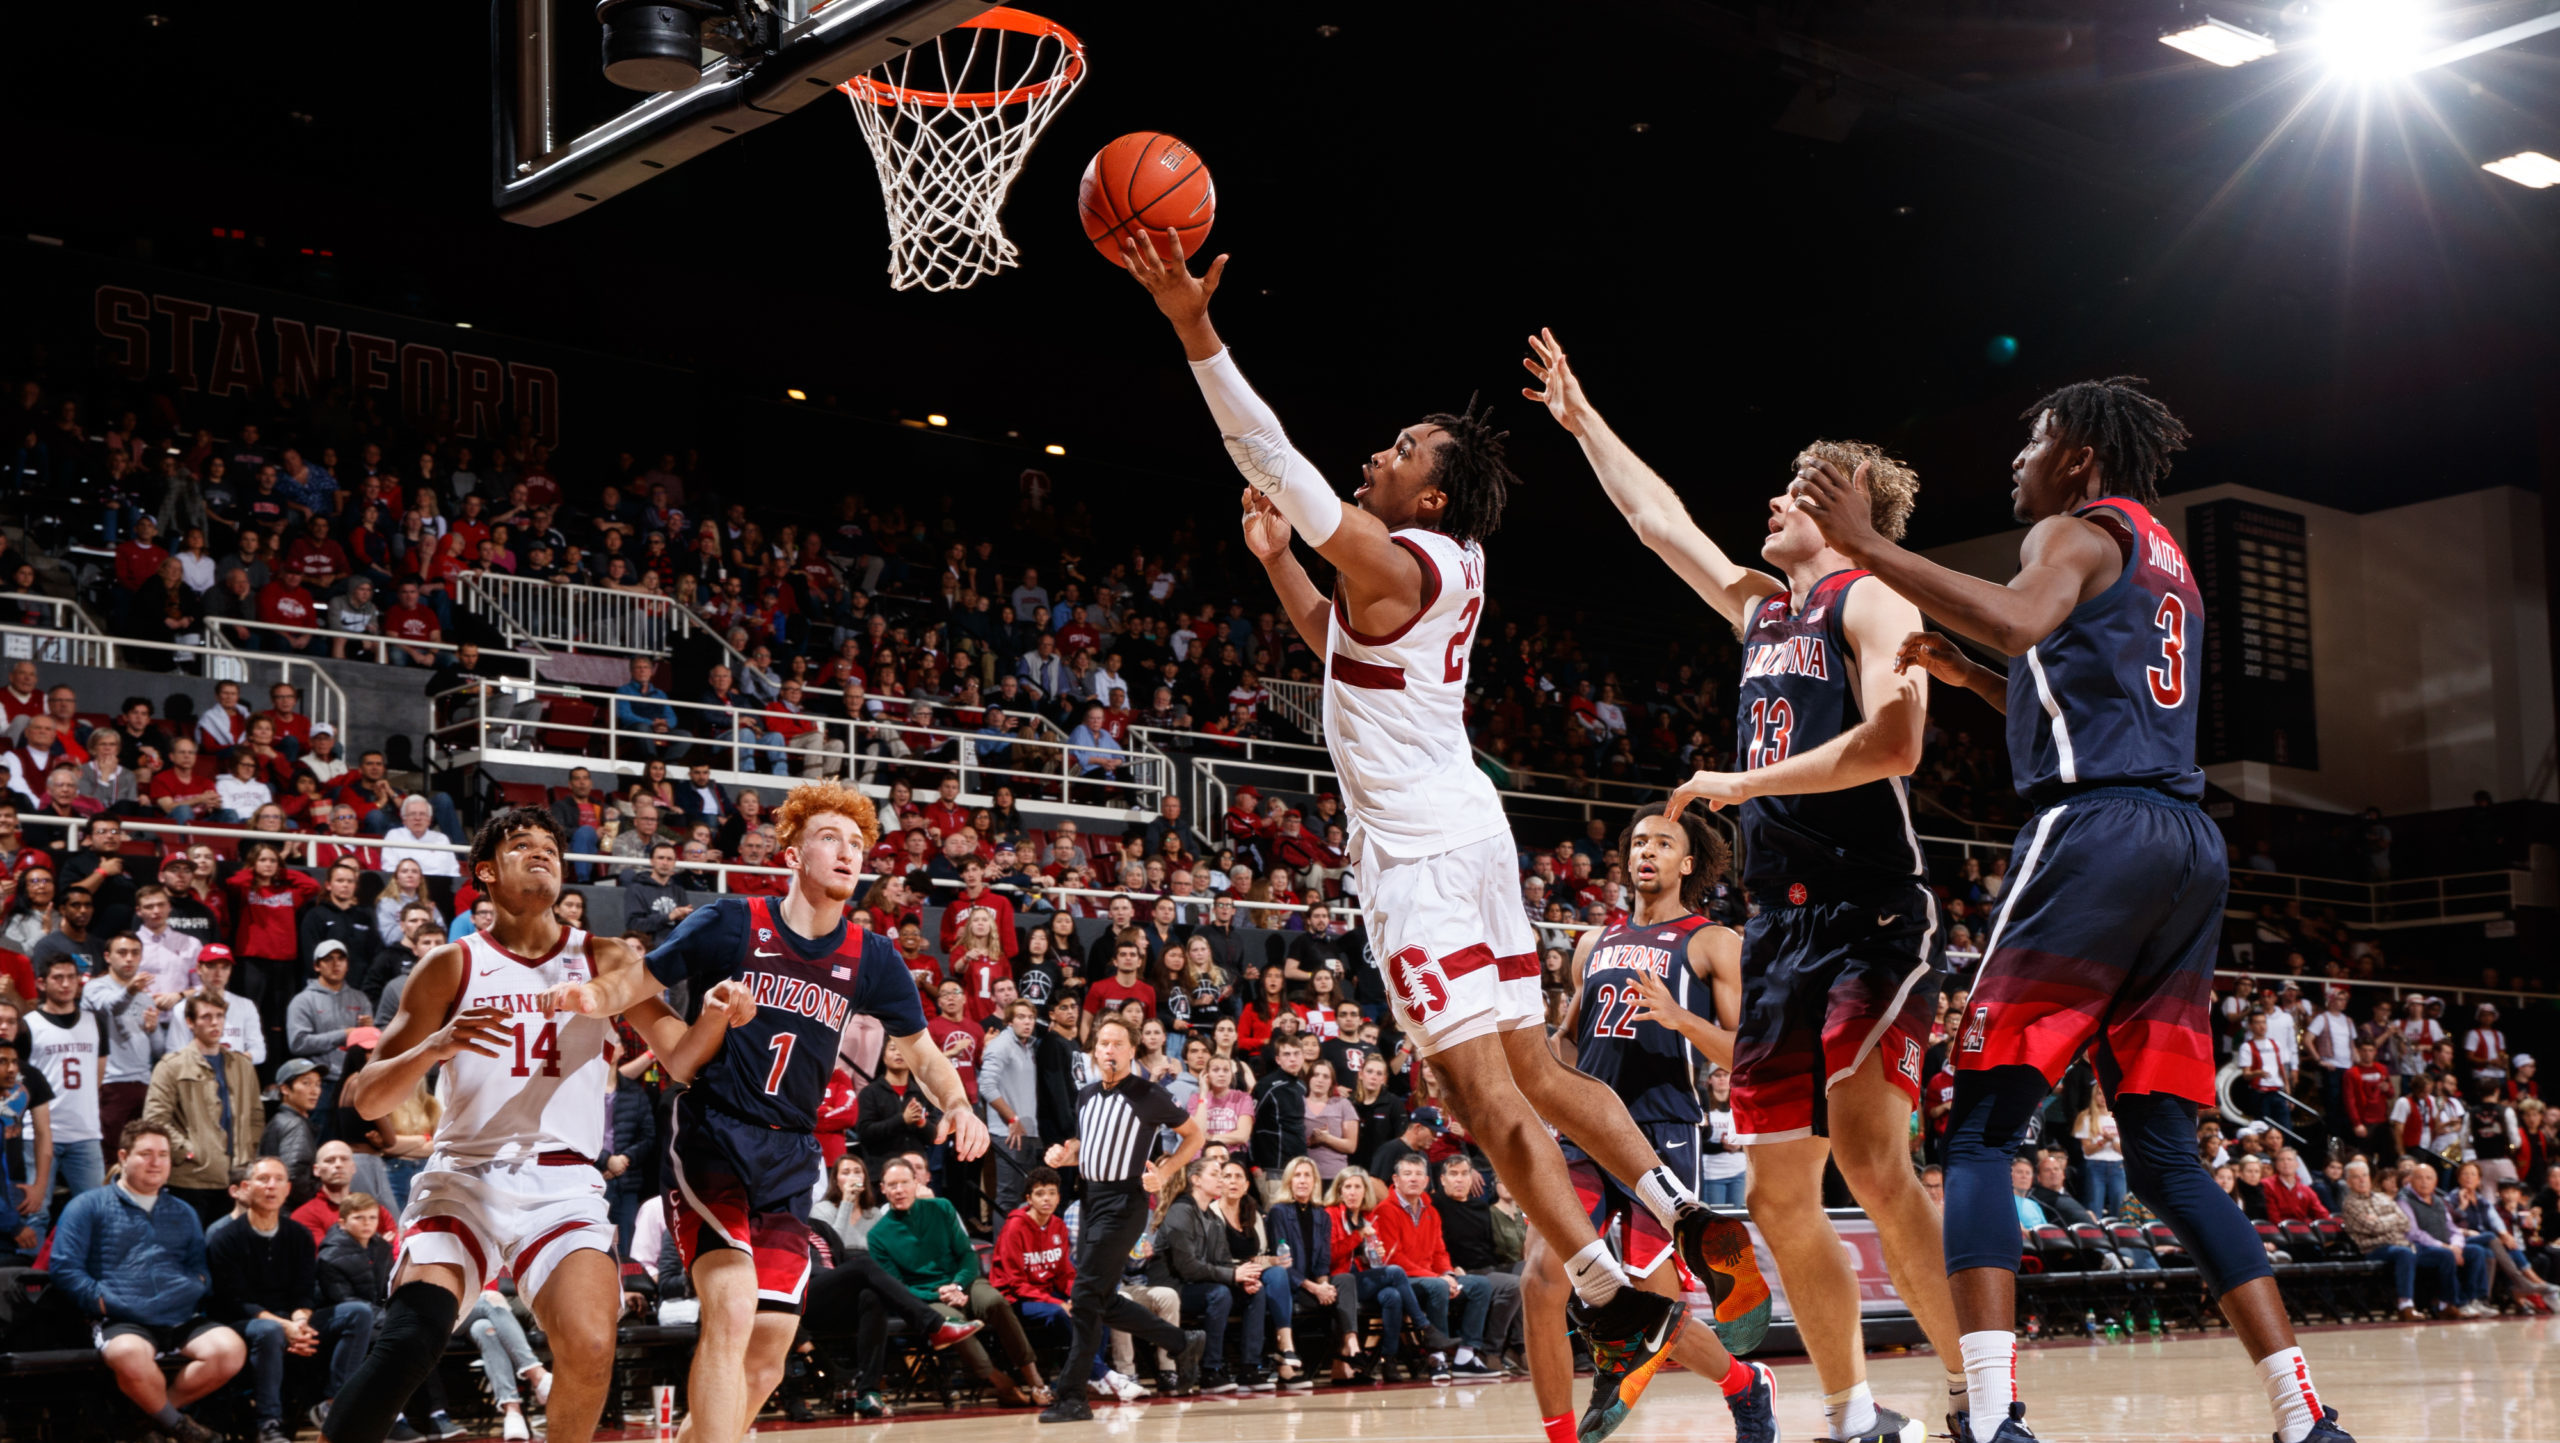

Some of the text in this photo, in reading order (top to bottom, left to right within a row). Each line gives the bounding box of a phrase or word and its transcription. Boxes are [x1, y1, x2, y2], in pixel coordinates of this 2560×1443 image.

[95, 285, 559, 452] STANFORD
[2149, 530, 2185, 583] SMITH
[1443, 596, 1480, 684] 2
[1740, 636, 1829, 682] ARIZONA
[2146, 592, 2186, 709] 3
[1748, 697, 1794, 772] 13
[979, 966, 991, 998] 1
[1587, 945, 1671, 979] ARIZONA
[473, 993, 563, 1013] STAN
[741, 971, 849, 1032] ARIZONA
[1594, 983, 1643, 1039] 22
[44, 1042, 94, 1056] STANFORD
[62, 1058, 82, 1090] 6
[511, 1022, 561, 1077] 14
[765, 1032, 797, 1096] 1
